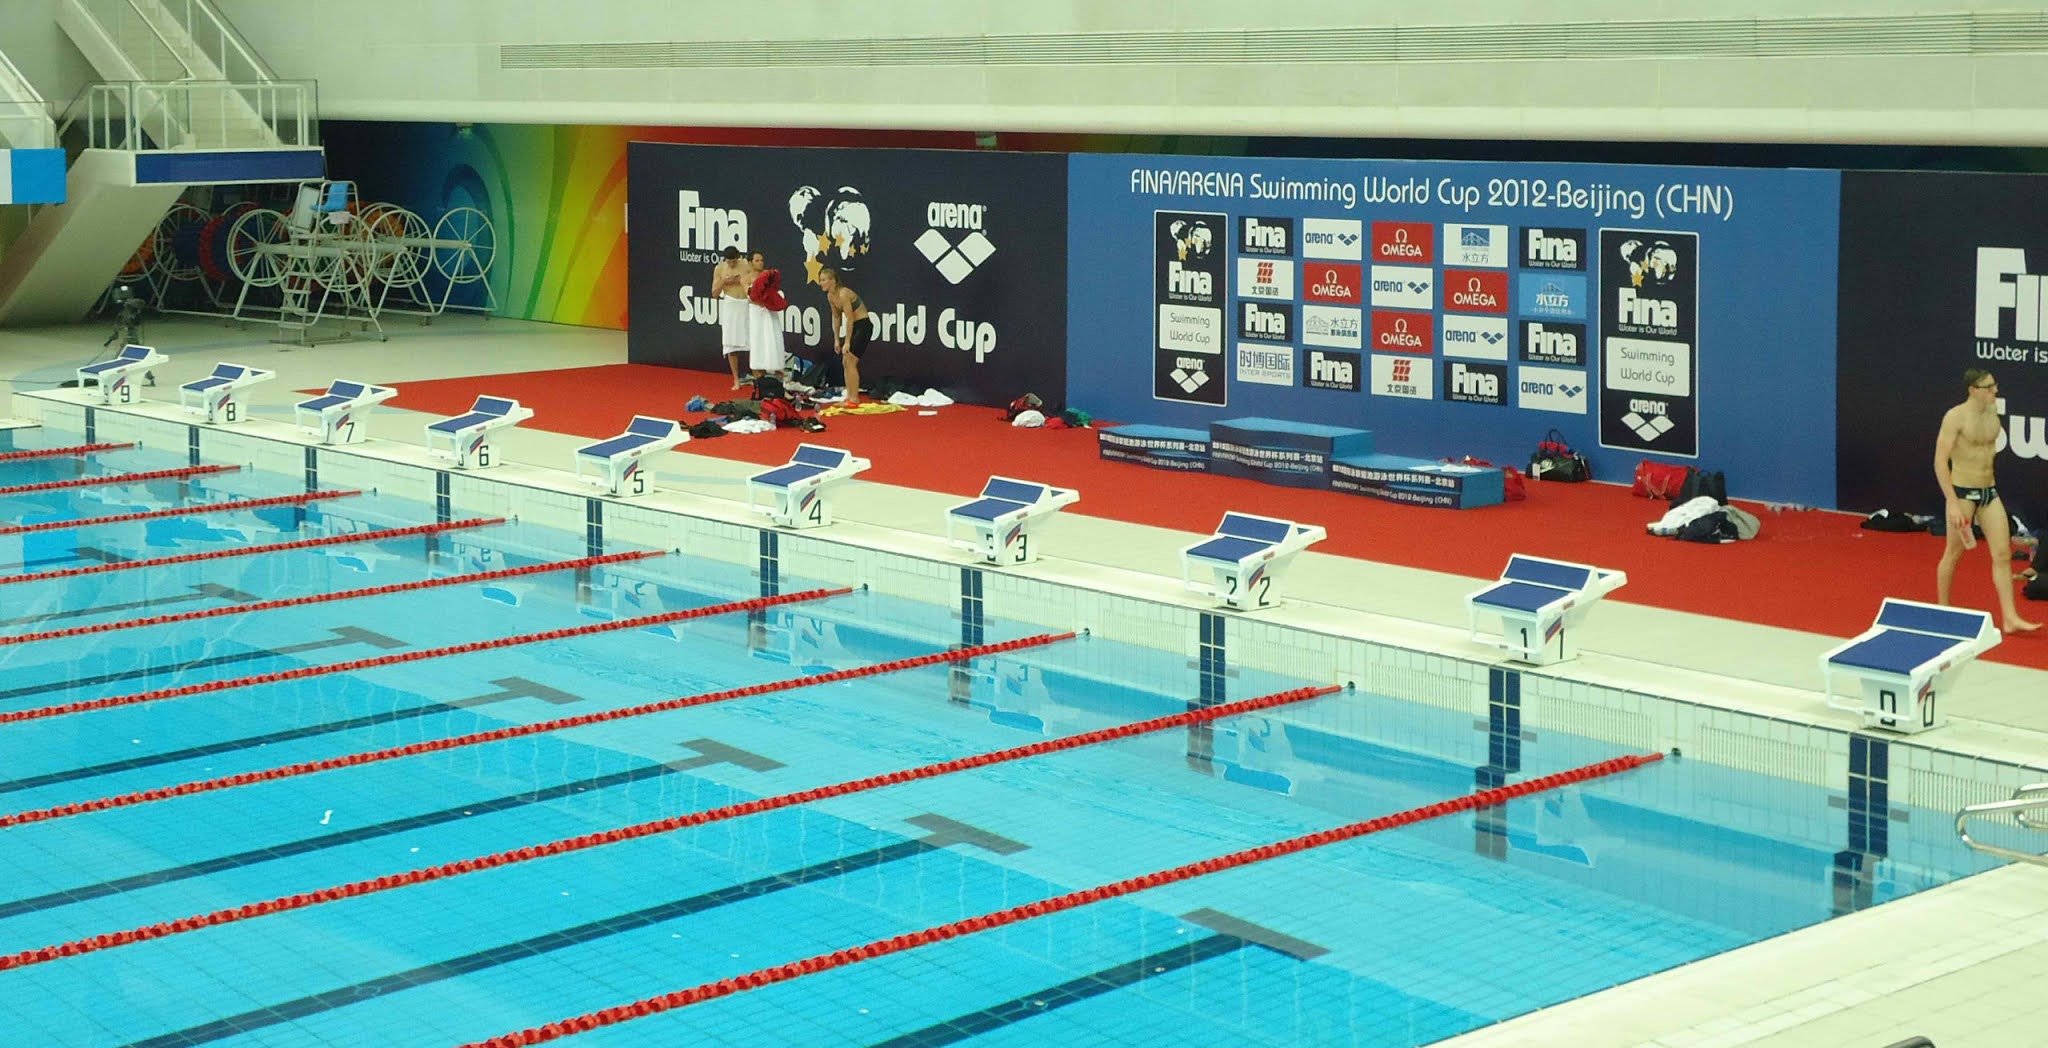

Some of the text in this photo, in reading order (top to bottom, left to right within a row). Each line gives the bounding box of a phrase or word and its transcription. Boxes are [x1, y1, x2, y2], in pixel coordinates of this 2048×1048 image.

[1131, 169, 1733, 221] FINA/ARENA Swimming World Cup 2012-Beijing (CHN)
[679, 190, 747, 253] Fina
[928, 202, 982, 229] arena
[1246, 218, 1285, 248] Fina
[1305, 232, 1333, 244] arena
[1381, 243, 1422, 257] OMEGA
[1528, 228, 1577, 262] Fina
[680, 251, 702, 263] Water
[703, 253, 710, 263] is
[1462, 252, 1489, 264] 水立方
[1169, 261, 1212, 294] Fina
[1373, 279, 1403, 292] arena
[1312, 284, 1351, 297] OMEGA
[1453, 292, 1497, 306] OMEGA
[1535, 293, 1569, 307] 水立方
[679, 285, 821, 347] Swng
[1619, 287, 1677, 328] Fina
[1170, 312, 1210, 328] Swimming
[1245, 303, 1285, 334] Fina
[1330, 317, 1358, 329] 水立方
[839, 303, 997, 363] orld Cup
[1170, 330, 1210, 345] World Cup
[1381, 332, 1422, 347] OMEGA
[1445, 329, 1476, 343] arena
[1528, 322, 1577, 356] Fina
[1619, 324, 1637, 332] Water
[1645, 325, 1657, 334] Our
[1658, 327, 1677, 336] World
[1240, 350, 1290, 370] 时博国际
[1621, 347, 1675, 367] Swimming
[1976, 341, 2028, 361] Water
[1176, 357, 1203, 370] arena
[1240, 367, 1291, 379] INTER SPORTS
[1311, 351, 1352, 383] Fina
[1452, 363, 1498, 396] Fina
[1620, 368, 1675, 387] World Cup
[121, 385, 130, 403] 9
[1521, 381, 1554, 395] arena
[227, 402, 236, 421] 8
[1630, 398, 1667, 415] arena
[346, 422, 355, 442] 7
[479, 445, 489, 467] 6
[633, 470, 644, 494] 5
[808, 499, 821, 525] 4
[1015, 534, 1027, 562] 3
[1226, 575, 1237, 607] 2
[1258, 576, 1271, 607] 2
[1520, 627, 1528, 660] 1
[1559, 627, 1564, 660] 1
[1880, 690, 1896, 727] 0
[1923, 691, 1935, 728] 0
